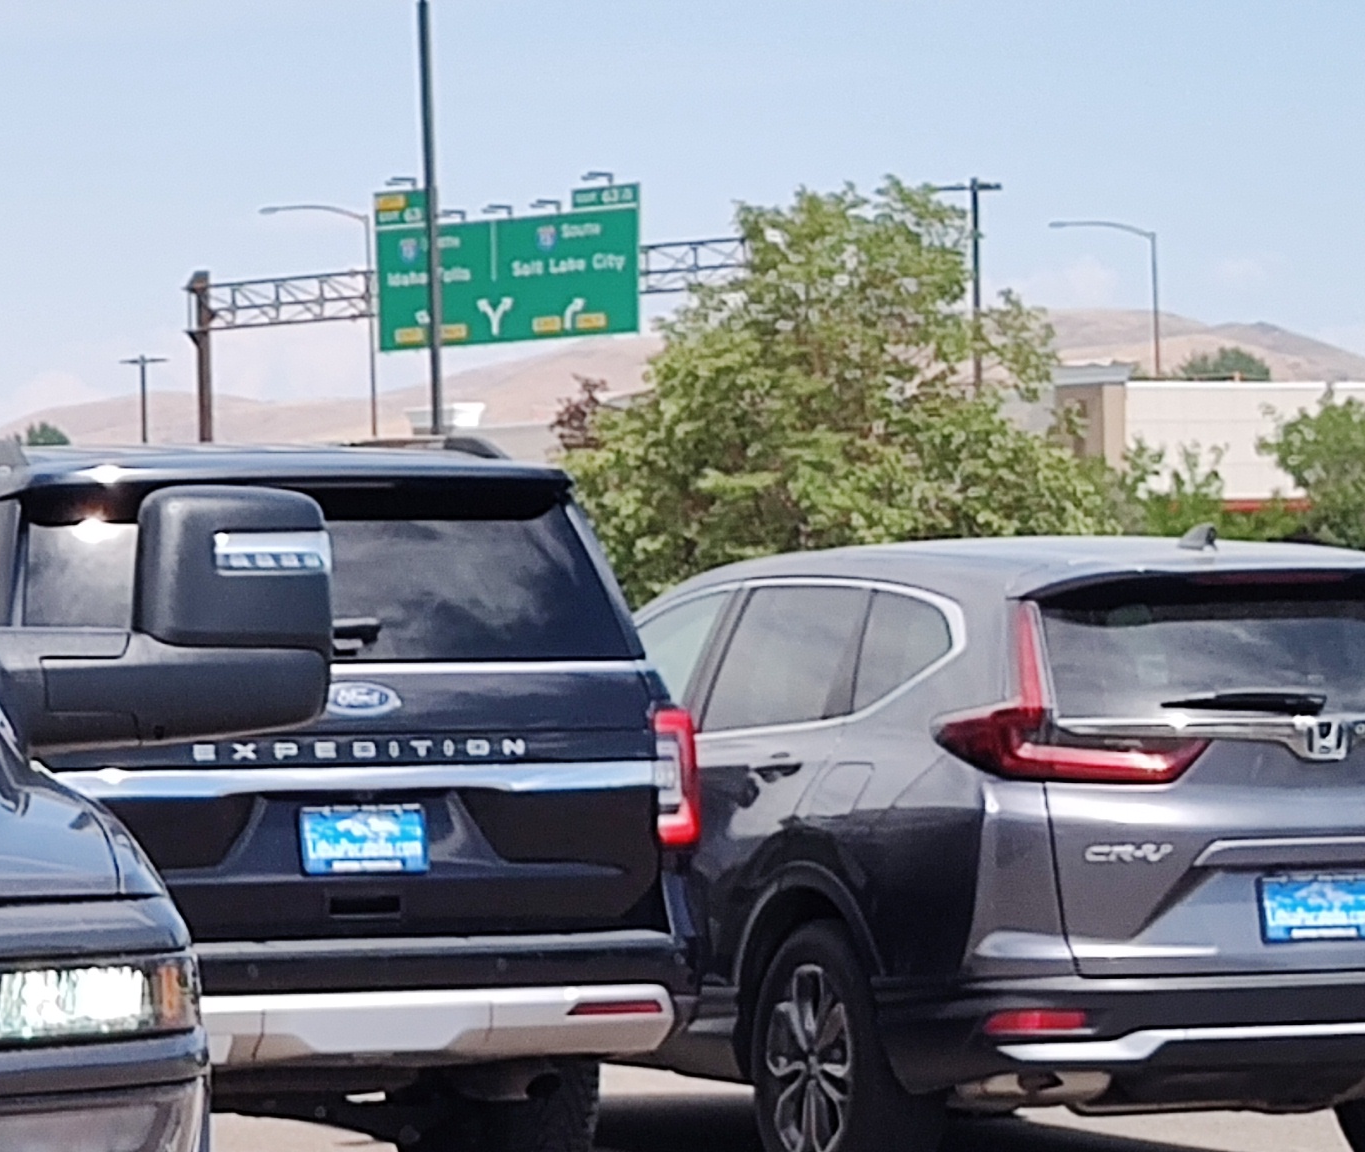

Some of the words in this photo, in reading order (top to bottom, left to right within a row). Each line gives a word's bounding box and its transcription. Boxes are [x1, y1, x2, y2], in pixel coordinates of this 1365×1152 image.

[511, 260, 544, 277] Salt
[591, 252, 626, 272] City
[191, 738, 527, 762] EXPEDITION
[1083, 841, 1174, 864] CR-V
